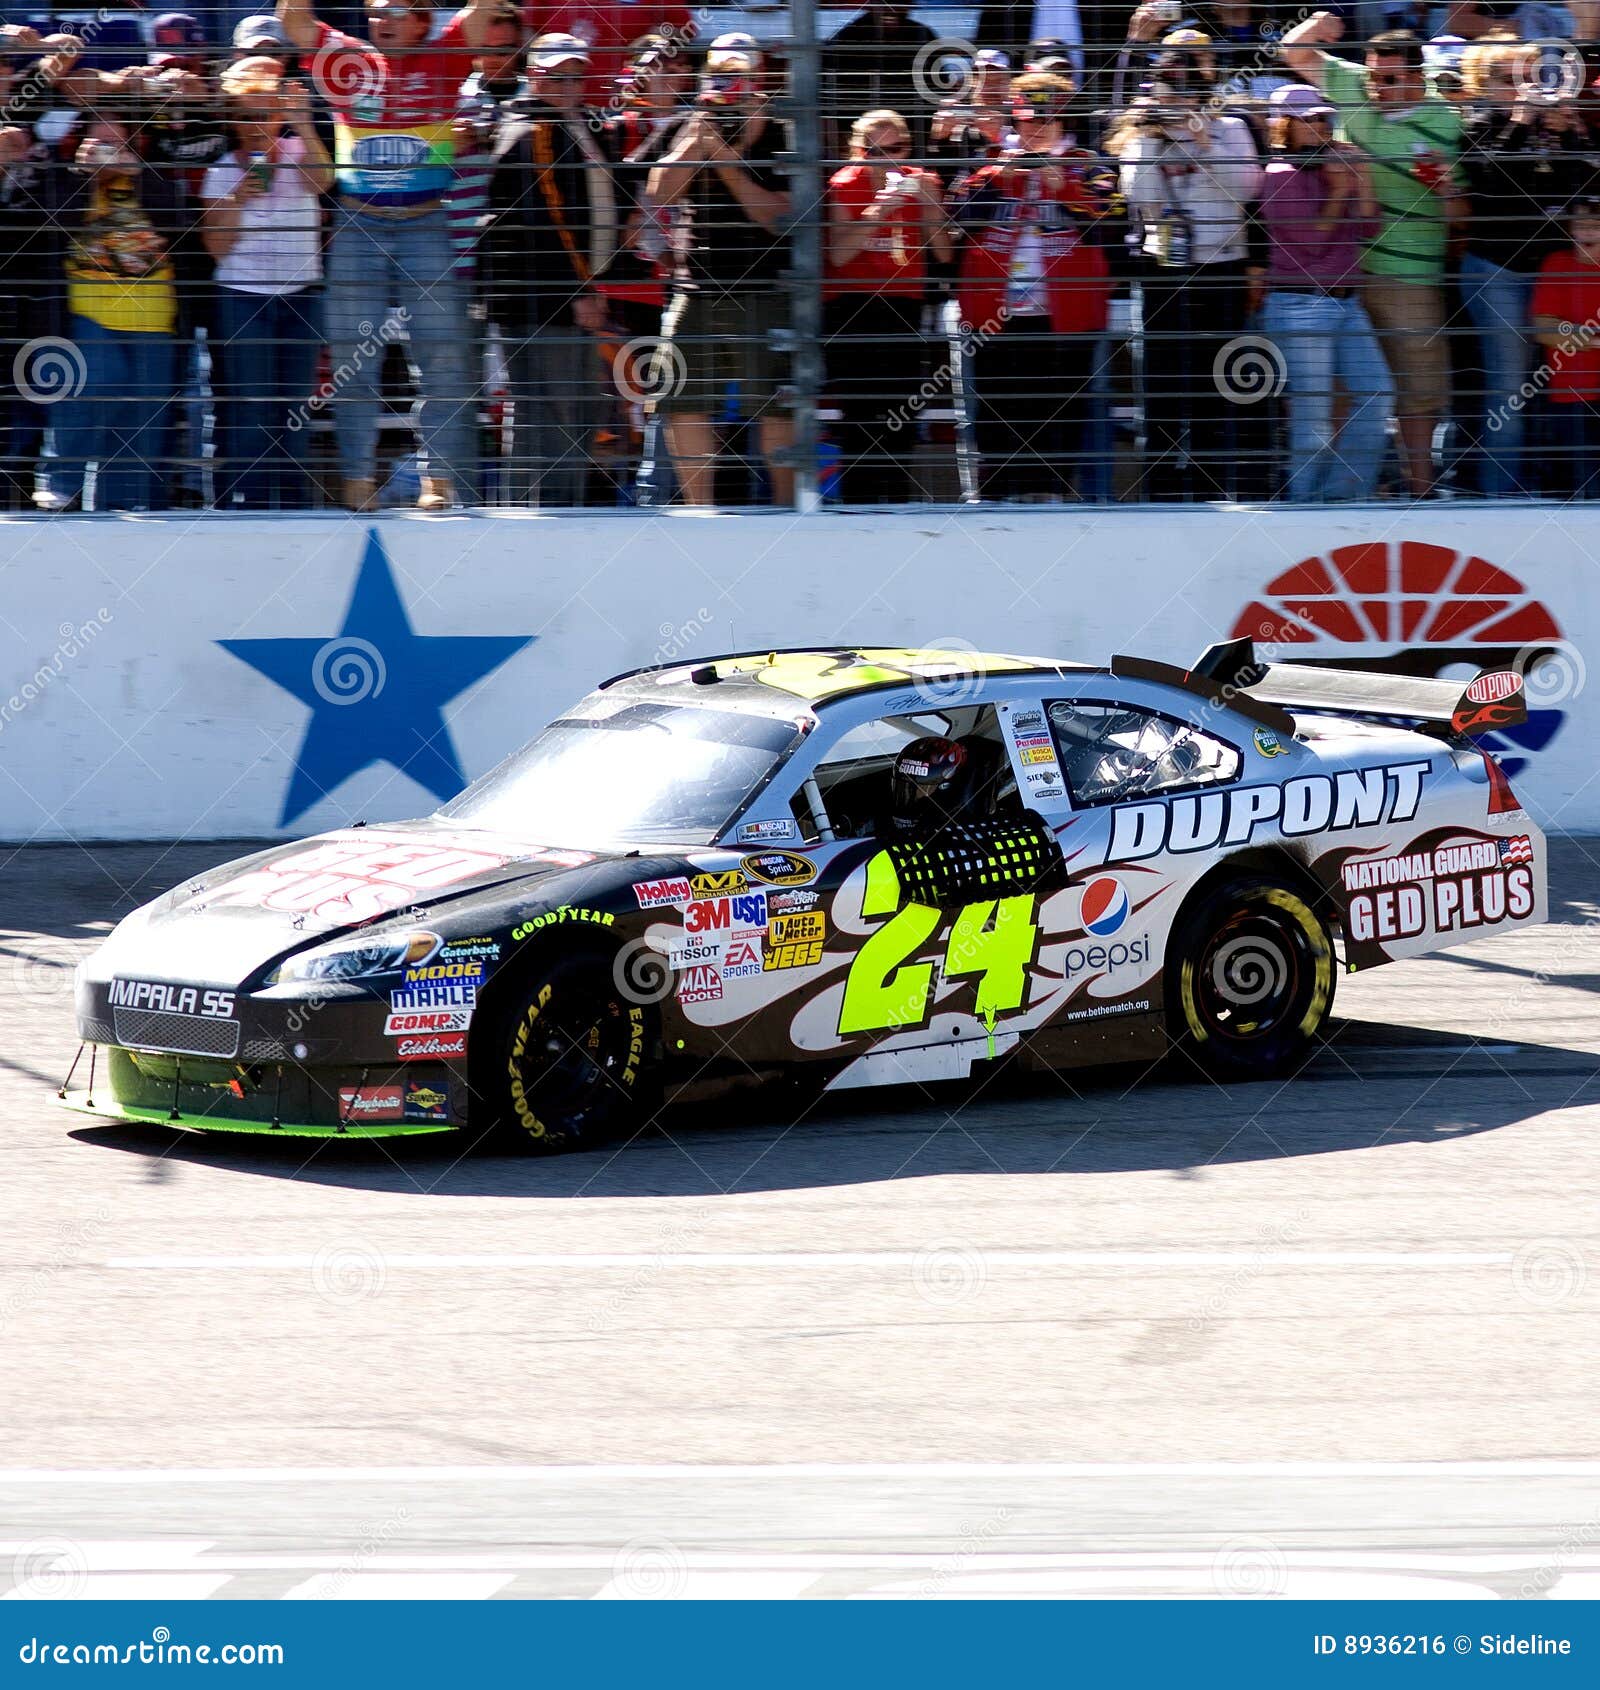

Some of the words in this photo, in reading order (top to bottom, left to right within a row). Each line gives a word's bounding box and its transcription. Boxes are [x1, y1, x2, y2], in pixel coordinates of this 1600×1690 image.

[1015, 737, 1050, 748] Purolator
[1031, 747, 1052, 756] BOSCH
[1033, 755, 1054, 763] BOSCH
[899, 763, 929, 777] GUARD
[1104, 760, 1433, 864] DUPONT
[758, 820, 785, 831] NASCAR
[760, 855, 786, 866] NASCAR
[767, 863, 793, 876] Sprint
[1343, 852, 1435, 891] NATIONAL
[1434, 841, 1498, 876] GUARD
[636, 880, 691, 902] Holley
[685, 897, 731, 933] 3M
[732, 893, 767, 928] USG
[777, 905, 814, 915] POLE
[1349, 887, 1424, 942] GED
[1436, 868, 1532, 929] PLUS
[511, 904, 616, 941] GOODYEAR
[783, 926, 822, 939] Meter
[786, 916, 816, 929] Auto
[439, 943, 502, 958] Gatorback
[837, 848, 1037, 1035] 24
[445, 954, 500, 964] BELTS
[671, 945, 720, 962] TISSOT
[724, 942, 759, 967] EA
[762, 940, 825, 972] JEGS
[1065, 933, 1150, 979] pepsi
[404, 961, 483, 983] MOOG
[679, 965, 722, 994] MAC
[722, 963, 761, 979] SPORTS
[108, 979, 196, 1014] IMPALA
[200, 990, 237, 1018] SS
[392, 986, 476, 1009] MAHLE
[678, 989, 723, 1003] TOOLS
[1067, 999, 1150, 1021] www.bethematch.org
[389, 1013, 452, 1031] COMP
[397, 1037, 466, 1057] Edelbrock
[621, 1007, 645, 1087] EAGLE
